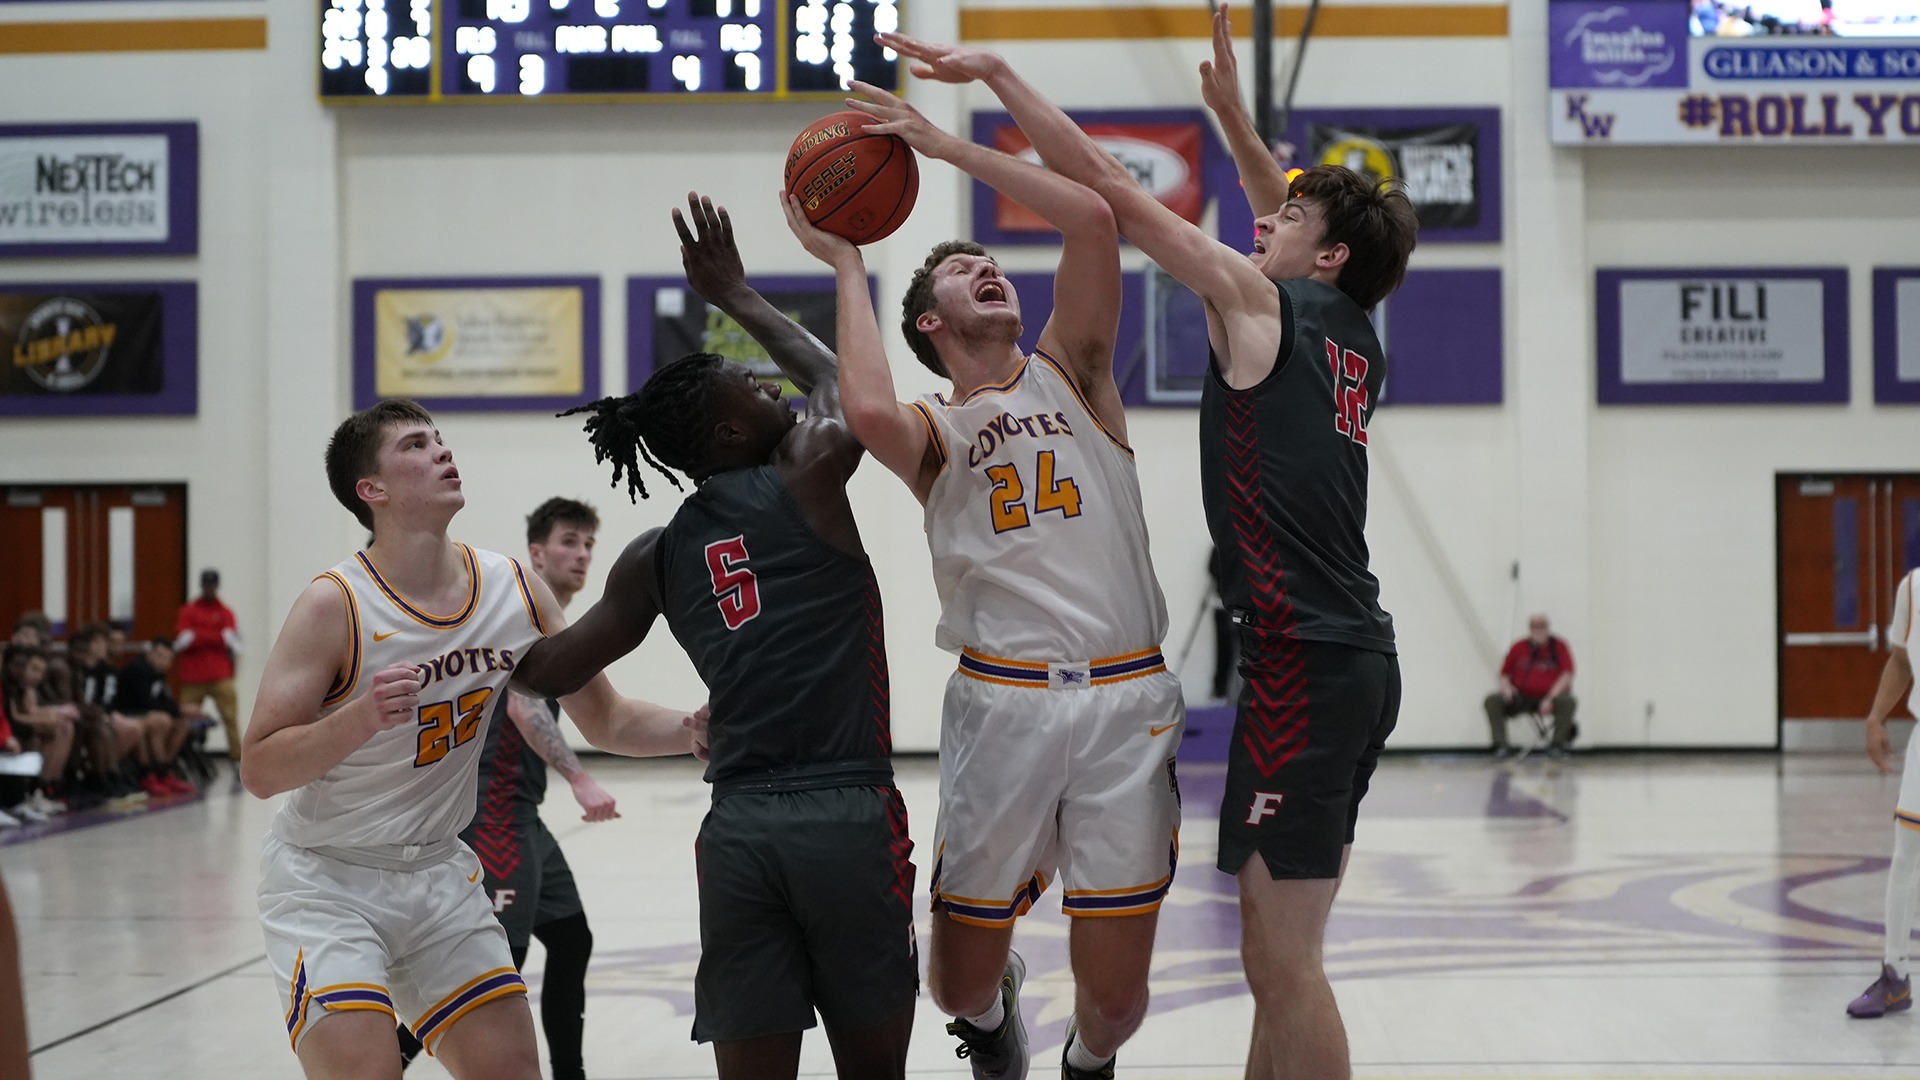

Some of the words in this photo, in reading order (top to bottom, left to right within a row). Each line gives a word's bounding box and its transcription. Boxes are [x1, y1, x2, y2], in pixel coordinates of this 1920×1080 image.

[1707, 50, 1846, 77] GLEASON
[1855, 52, 1877, 76] &
[784, 121, 850, 182] SPALDING
[1680, 284, 1767, 321] FILI
[1681, 327, 1767, 344] CREATIVE
[1325, 336, 1369, 446] 12
[969, 411, 1074, 467] COYOTES
[984, 449, 1083, 534] 24
[705, 534, 761, 630] 5
[416, 648, 515, 690] OYOTES
[414, 687, 494, 768] 22
[1246, 791, 1283, 826] F
[492, 888, 516, 913] F
